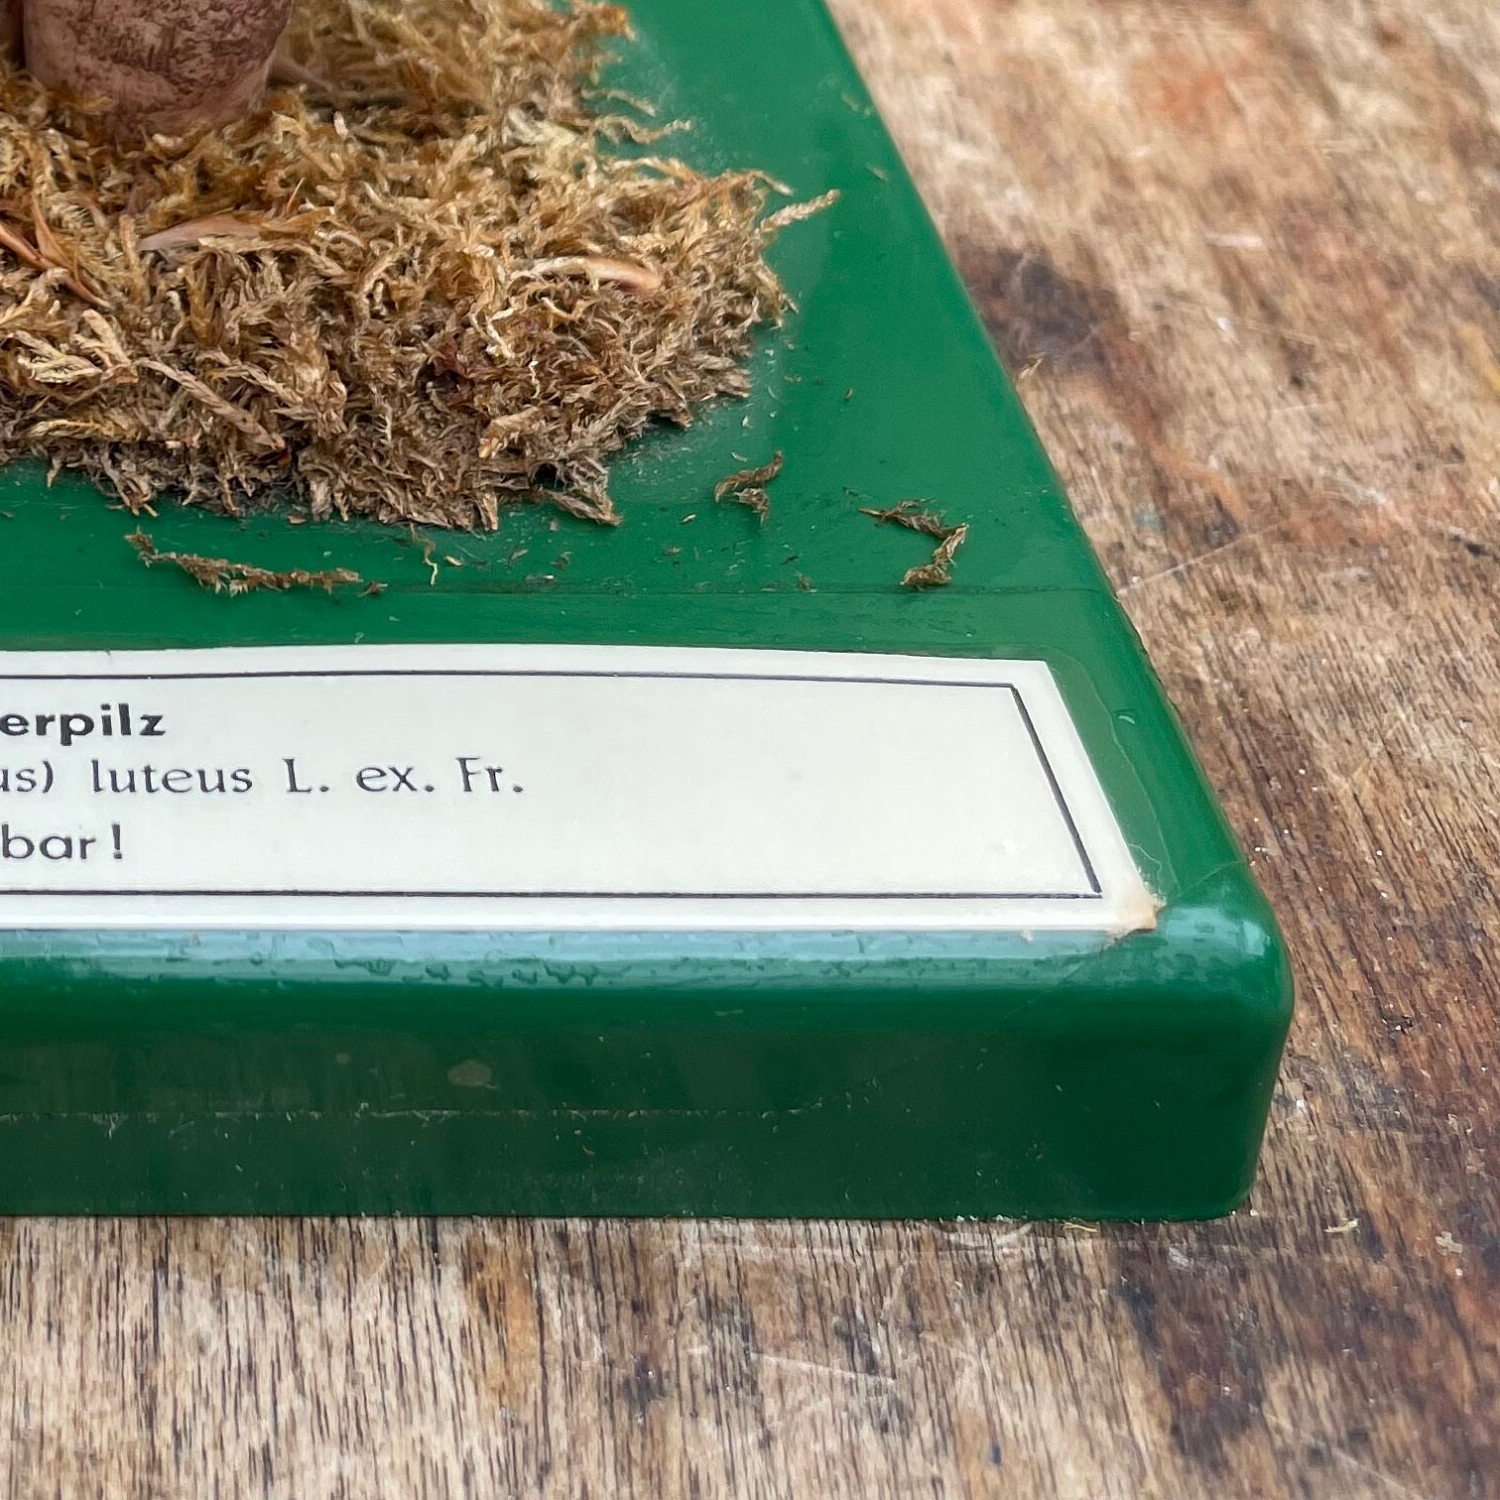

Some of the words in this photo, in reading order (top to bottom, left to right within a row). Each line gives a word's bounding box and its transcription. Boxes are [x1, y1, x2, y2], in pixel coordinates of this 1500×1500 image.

[91, 759, 254, 794] luteus
[282, 757, 331, 794] L.
[355, 764, 436, 794] ex.
[455, 756, 525, 794] Fr.
